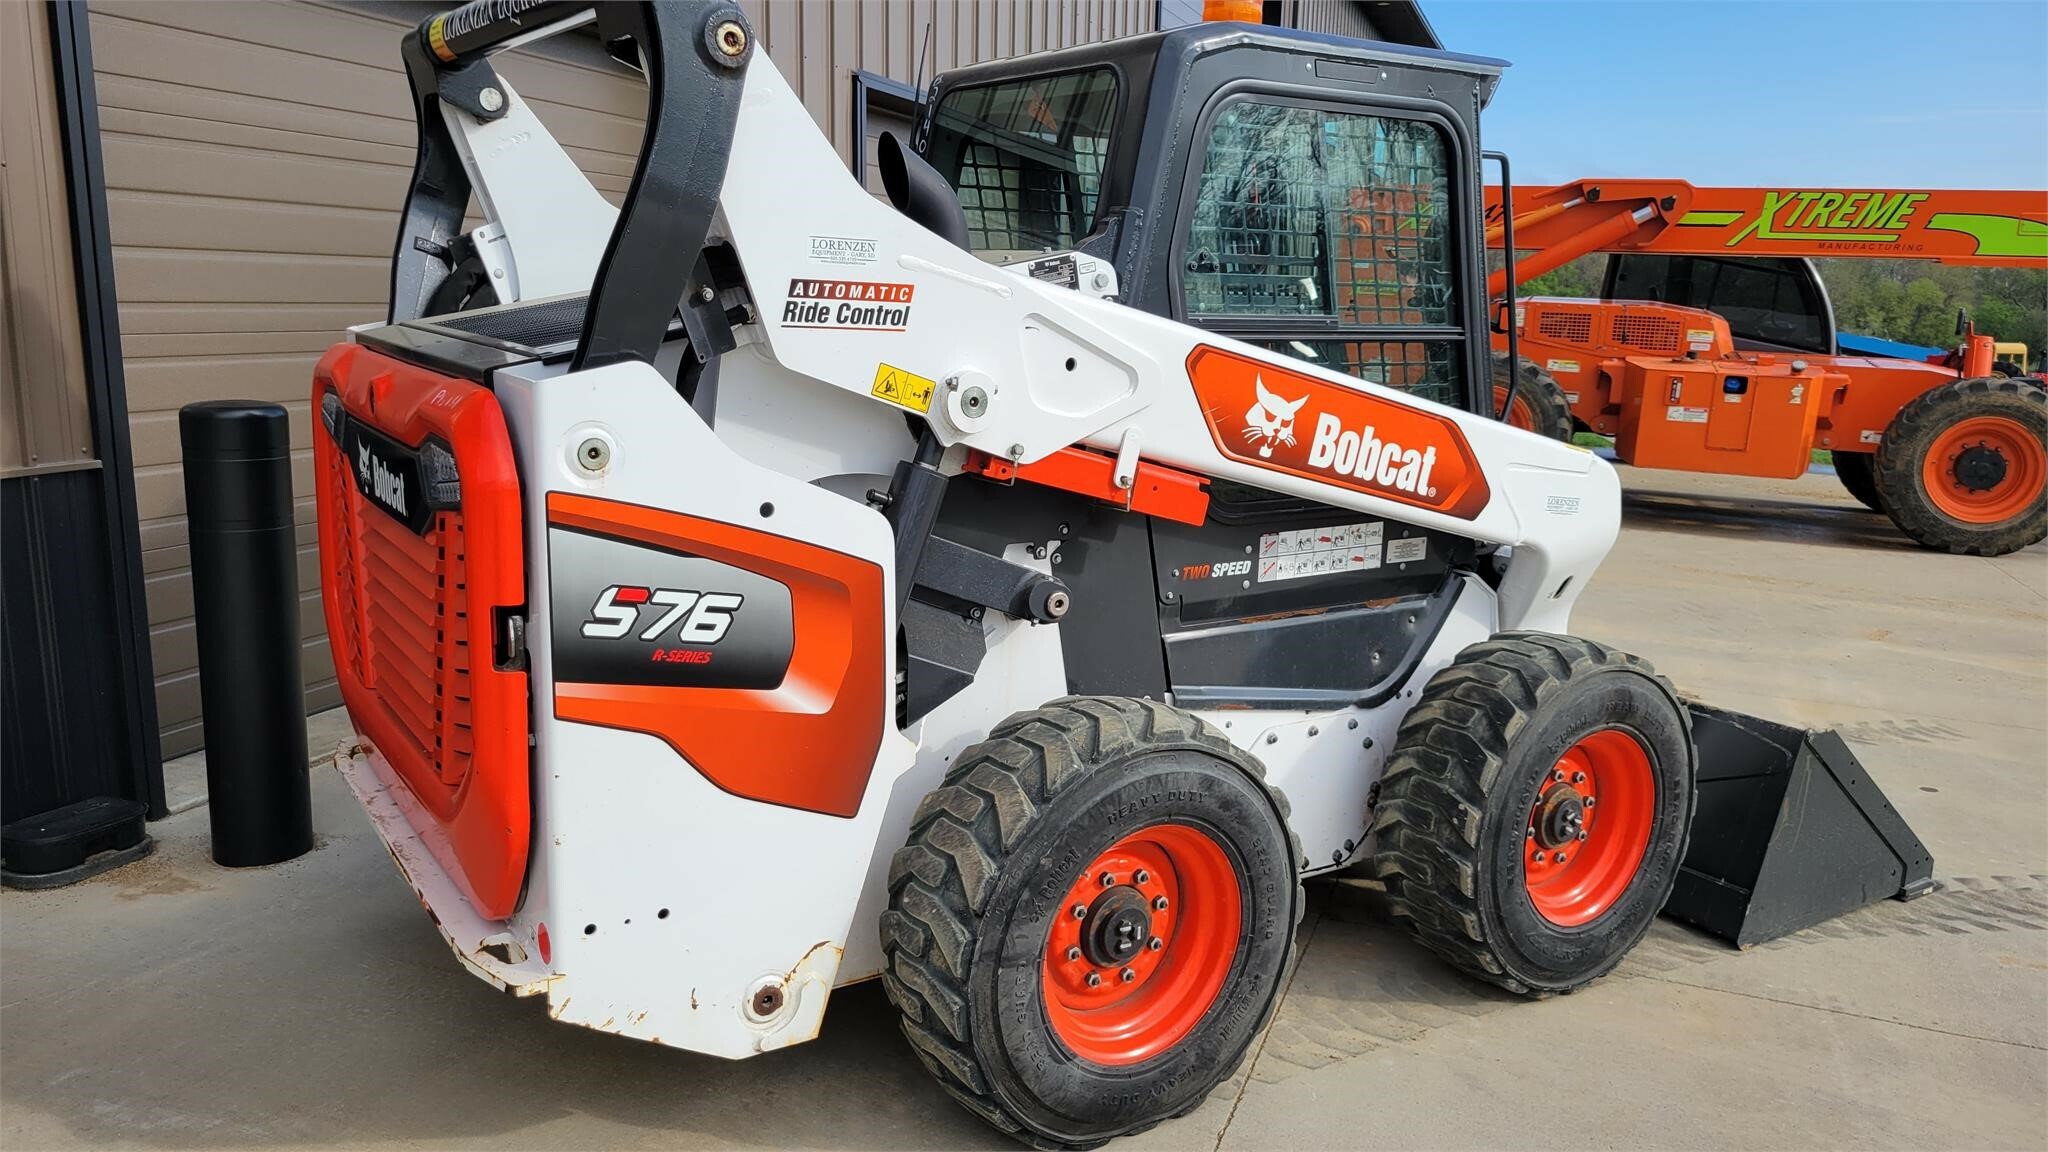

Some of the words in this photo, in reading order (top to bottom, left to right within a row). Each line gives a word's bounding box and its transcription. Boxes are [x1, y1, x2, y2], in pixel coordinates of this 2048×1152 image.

[1725, 190, 1930, 248] XTREME
[811, 238, 876, 253] LORENZEN
[1818, 242, 1926, 252] MANUFACTURING
[793, 281, 911, 301] AUTOMATIC
[782, 301, 830, 324] Ride
[836, 302, 911, 327] Control
[1307, 411, 1437, 496] Bobcat
[372, 454, 407, 517] Bobcat
[1183, 563, 1210, 581] TWO
[1211, 560, 1252, 578] SPEED
[579, 584, 745, 645] S76
[652, 648, 713, 664] R-SERIES
[1108, 792, 1161, 826] HEAVY
[1167, 790, 1208, 804] DUTY
